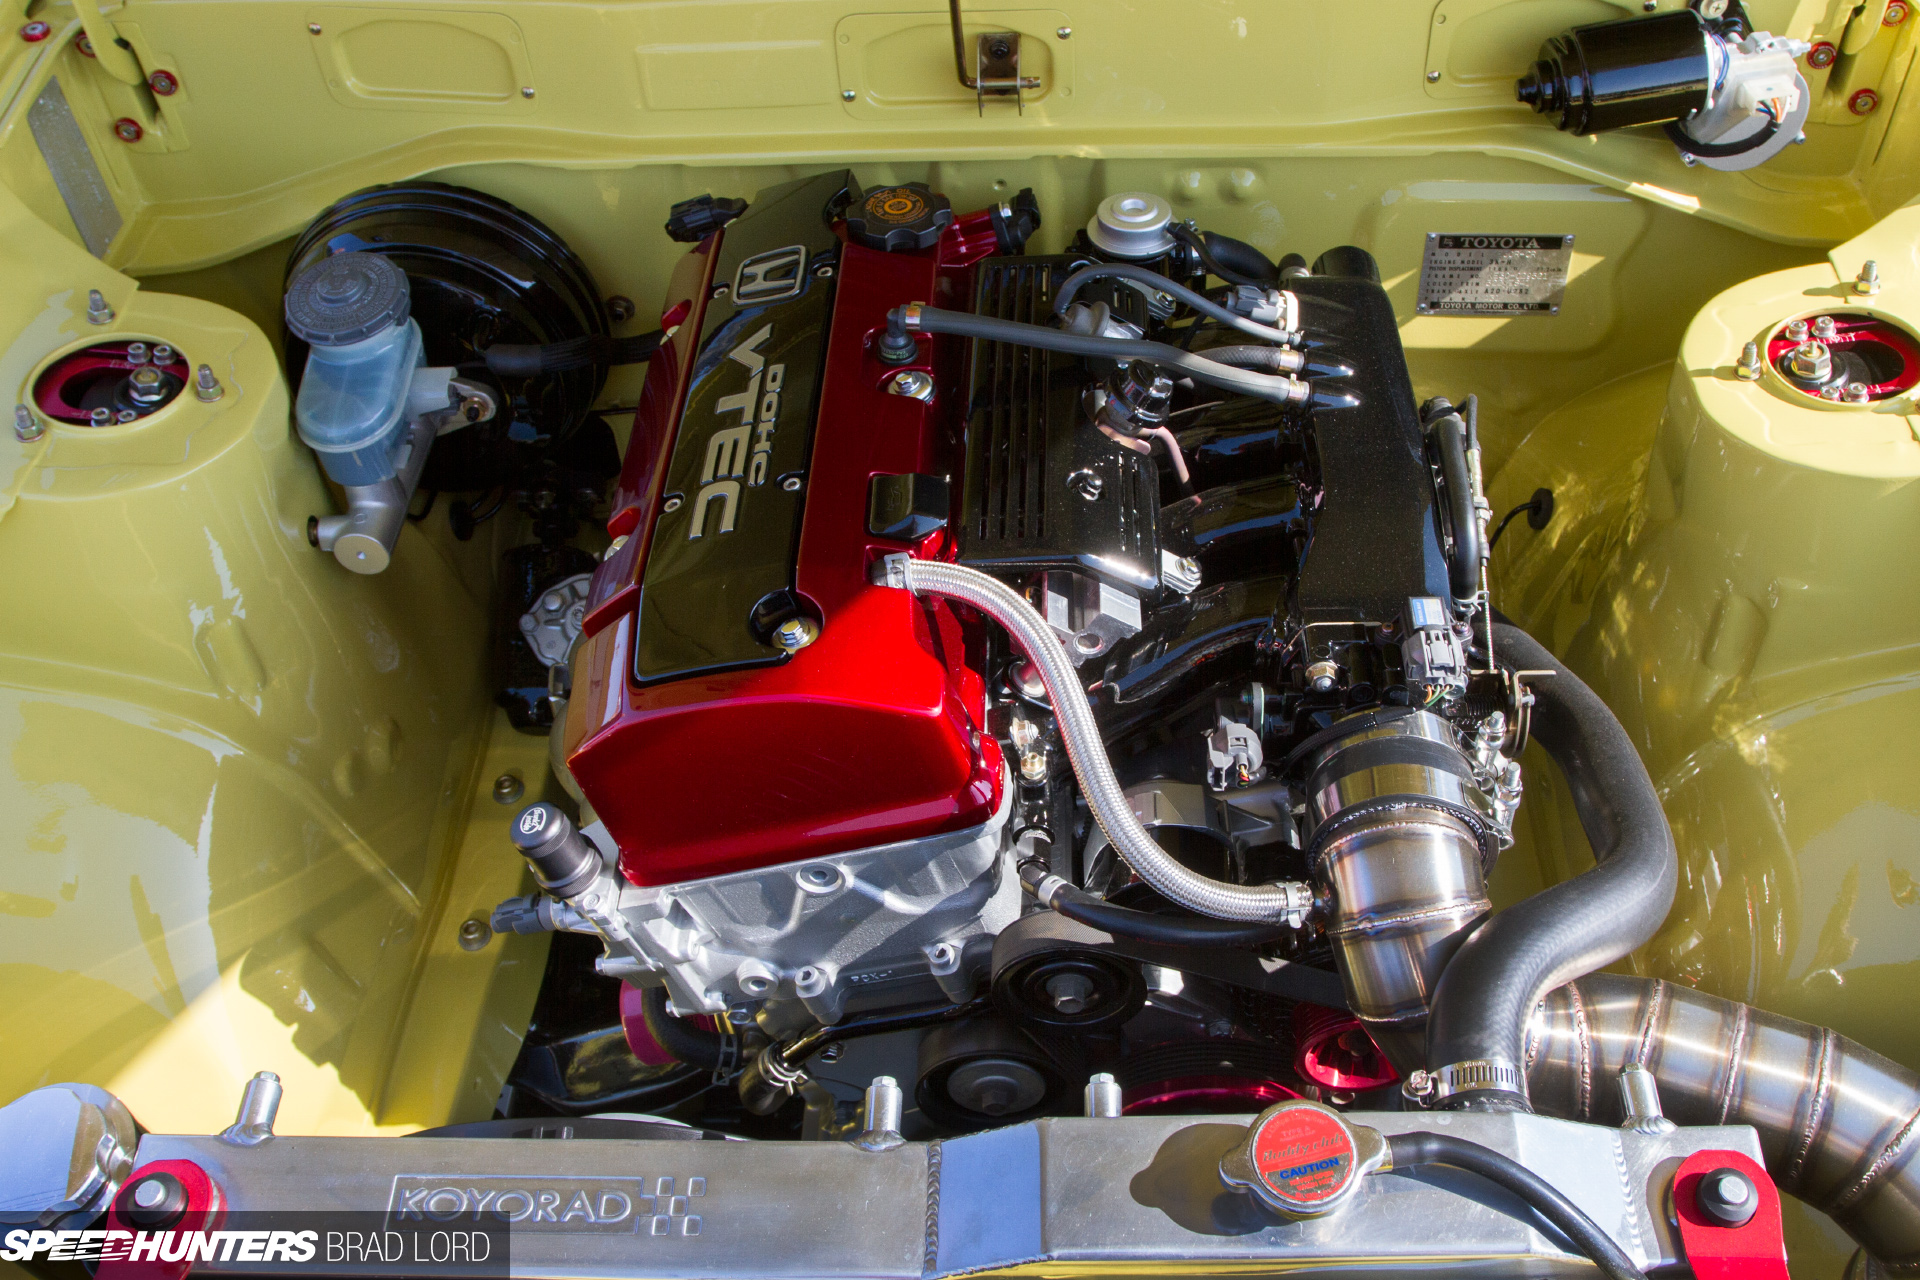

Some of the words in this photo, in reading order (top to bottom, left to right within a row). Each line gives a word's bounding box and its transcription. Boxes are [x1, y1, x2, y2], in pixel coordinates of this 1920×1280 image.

[1460, 237, 1540, 249] TOYOTA
[1440, 302, 1472, 310] TOYOTA
[1475, 302, 1504, 310] MOTOR
[688, 322, 773, 541] VTEC
[747, 363, 786, 488] DOHC
[1279, 1157, 1340, 1180] CAUTION
[1289, 1175, 1314, 1187] NEVER
[1314, 1170, 1335, 1181] OPEN
[396, 1187, 632, 1223] KOYORAD
